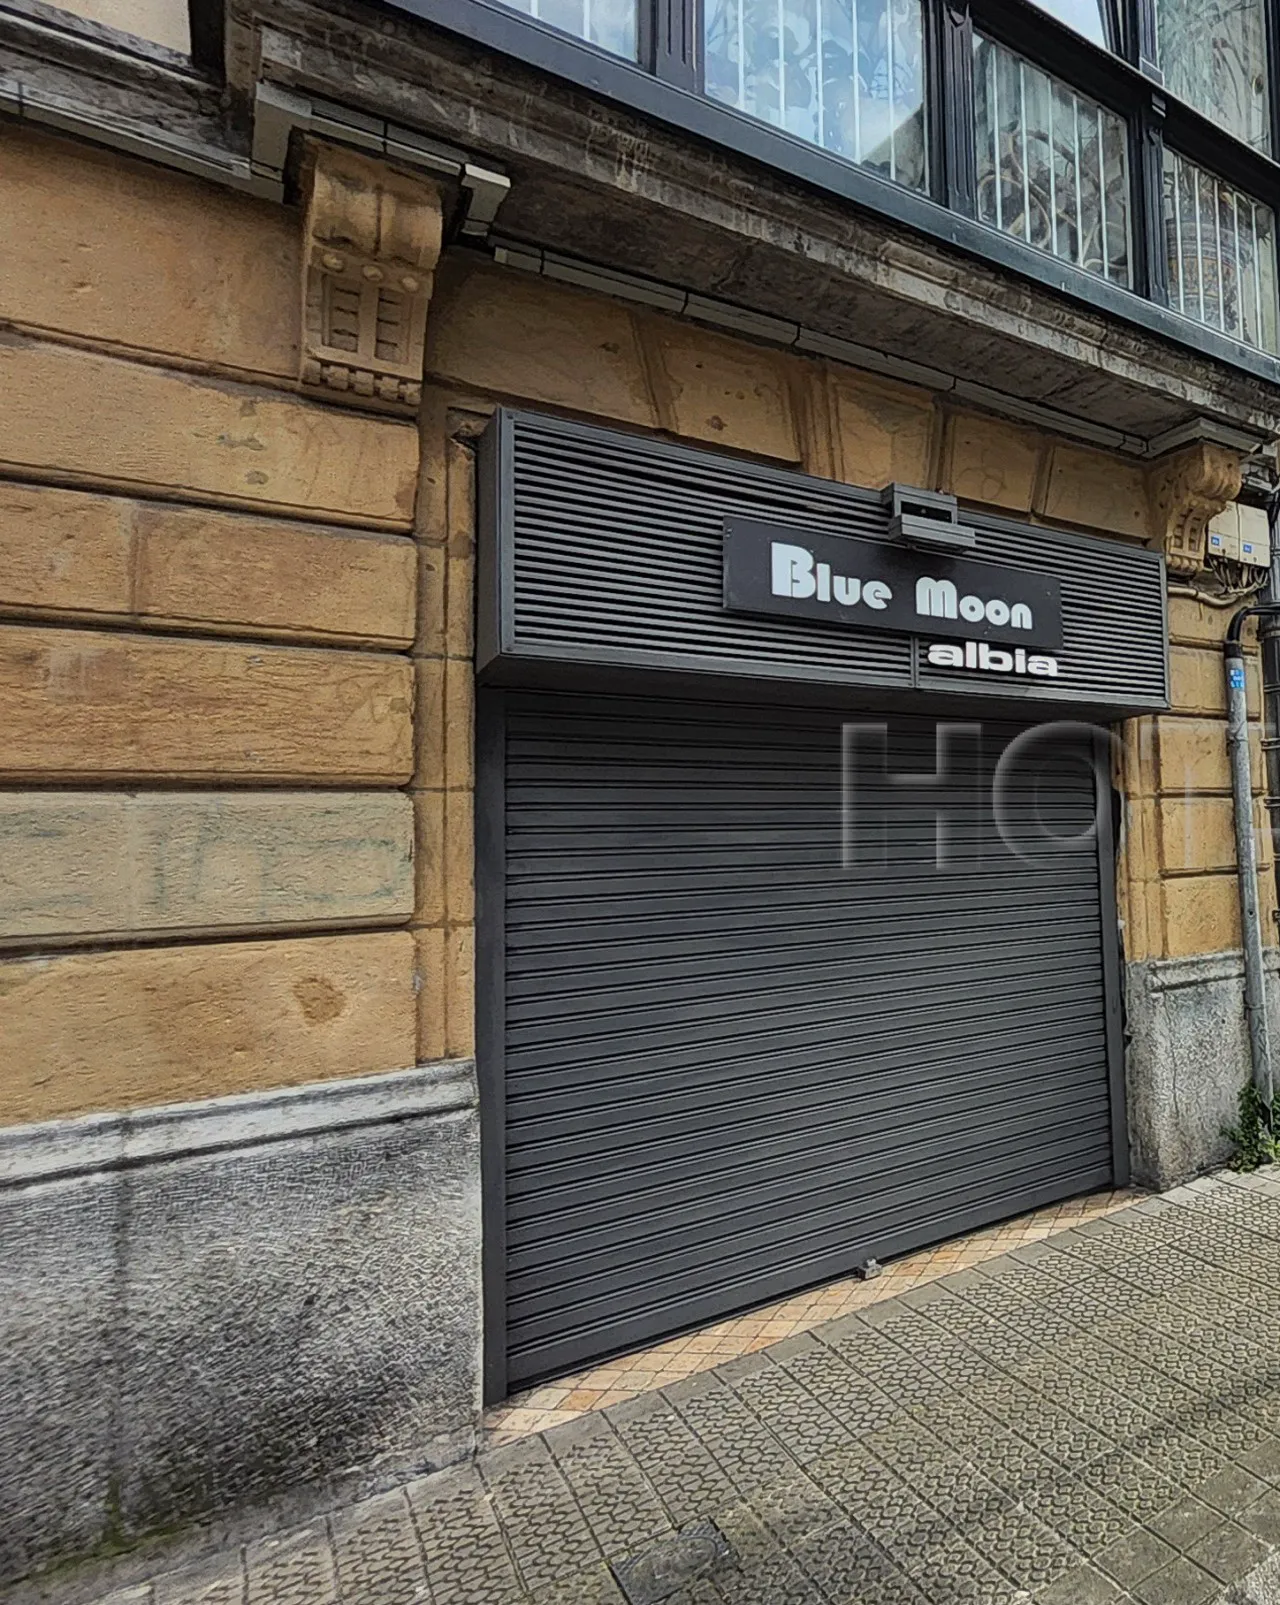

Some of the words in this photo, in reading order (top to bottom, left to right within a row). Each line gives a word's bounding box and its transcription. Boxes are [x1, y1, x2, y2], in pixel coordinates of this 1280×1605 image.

[770, 541, 893, 610] Blue
[915, 575, 1033, 630] Moon
[927, 641, 1059, 677] albia
